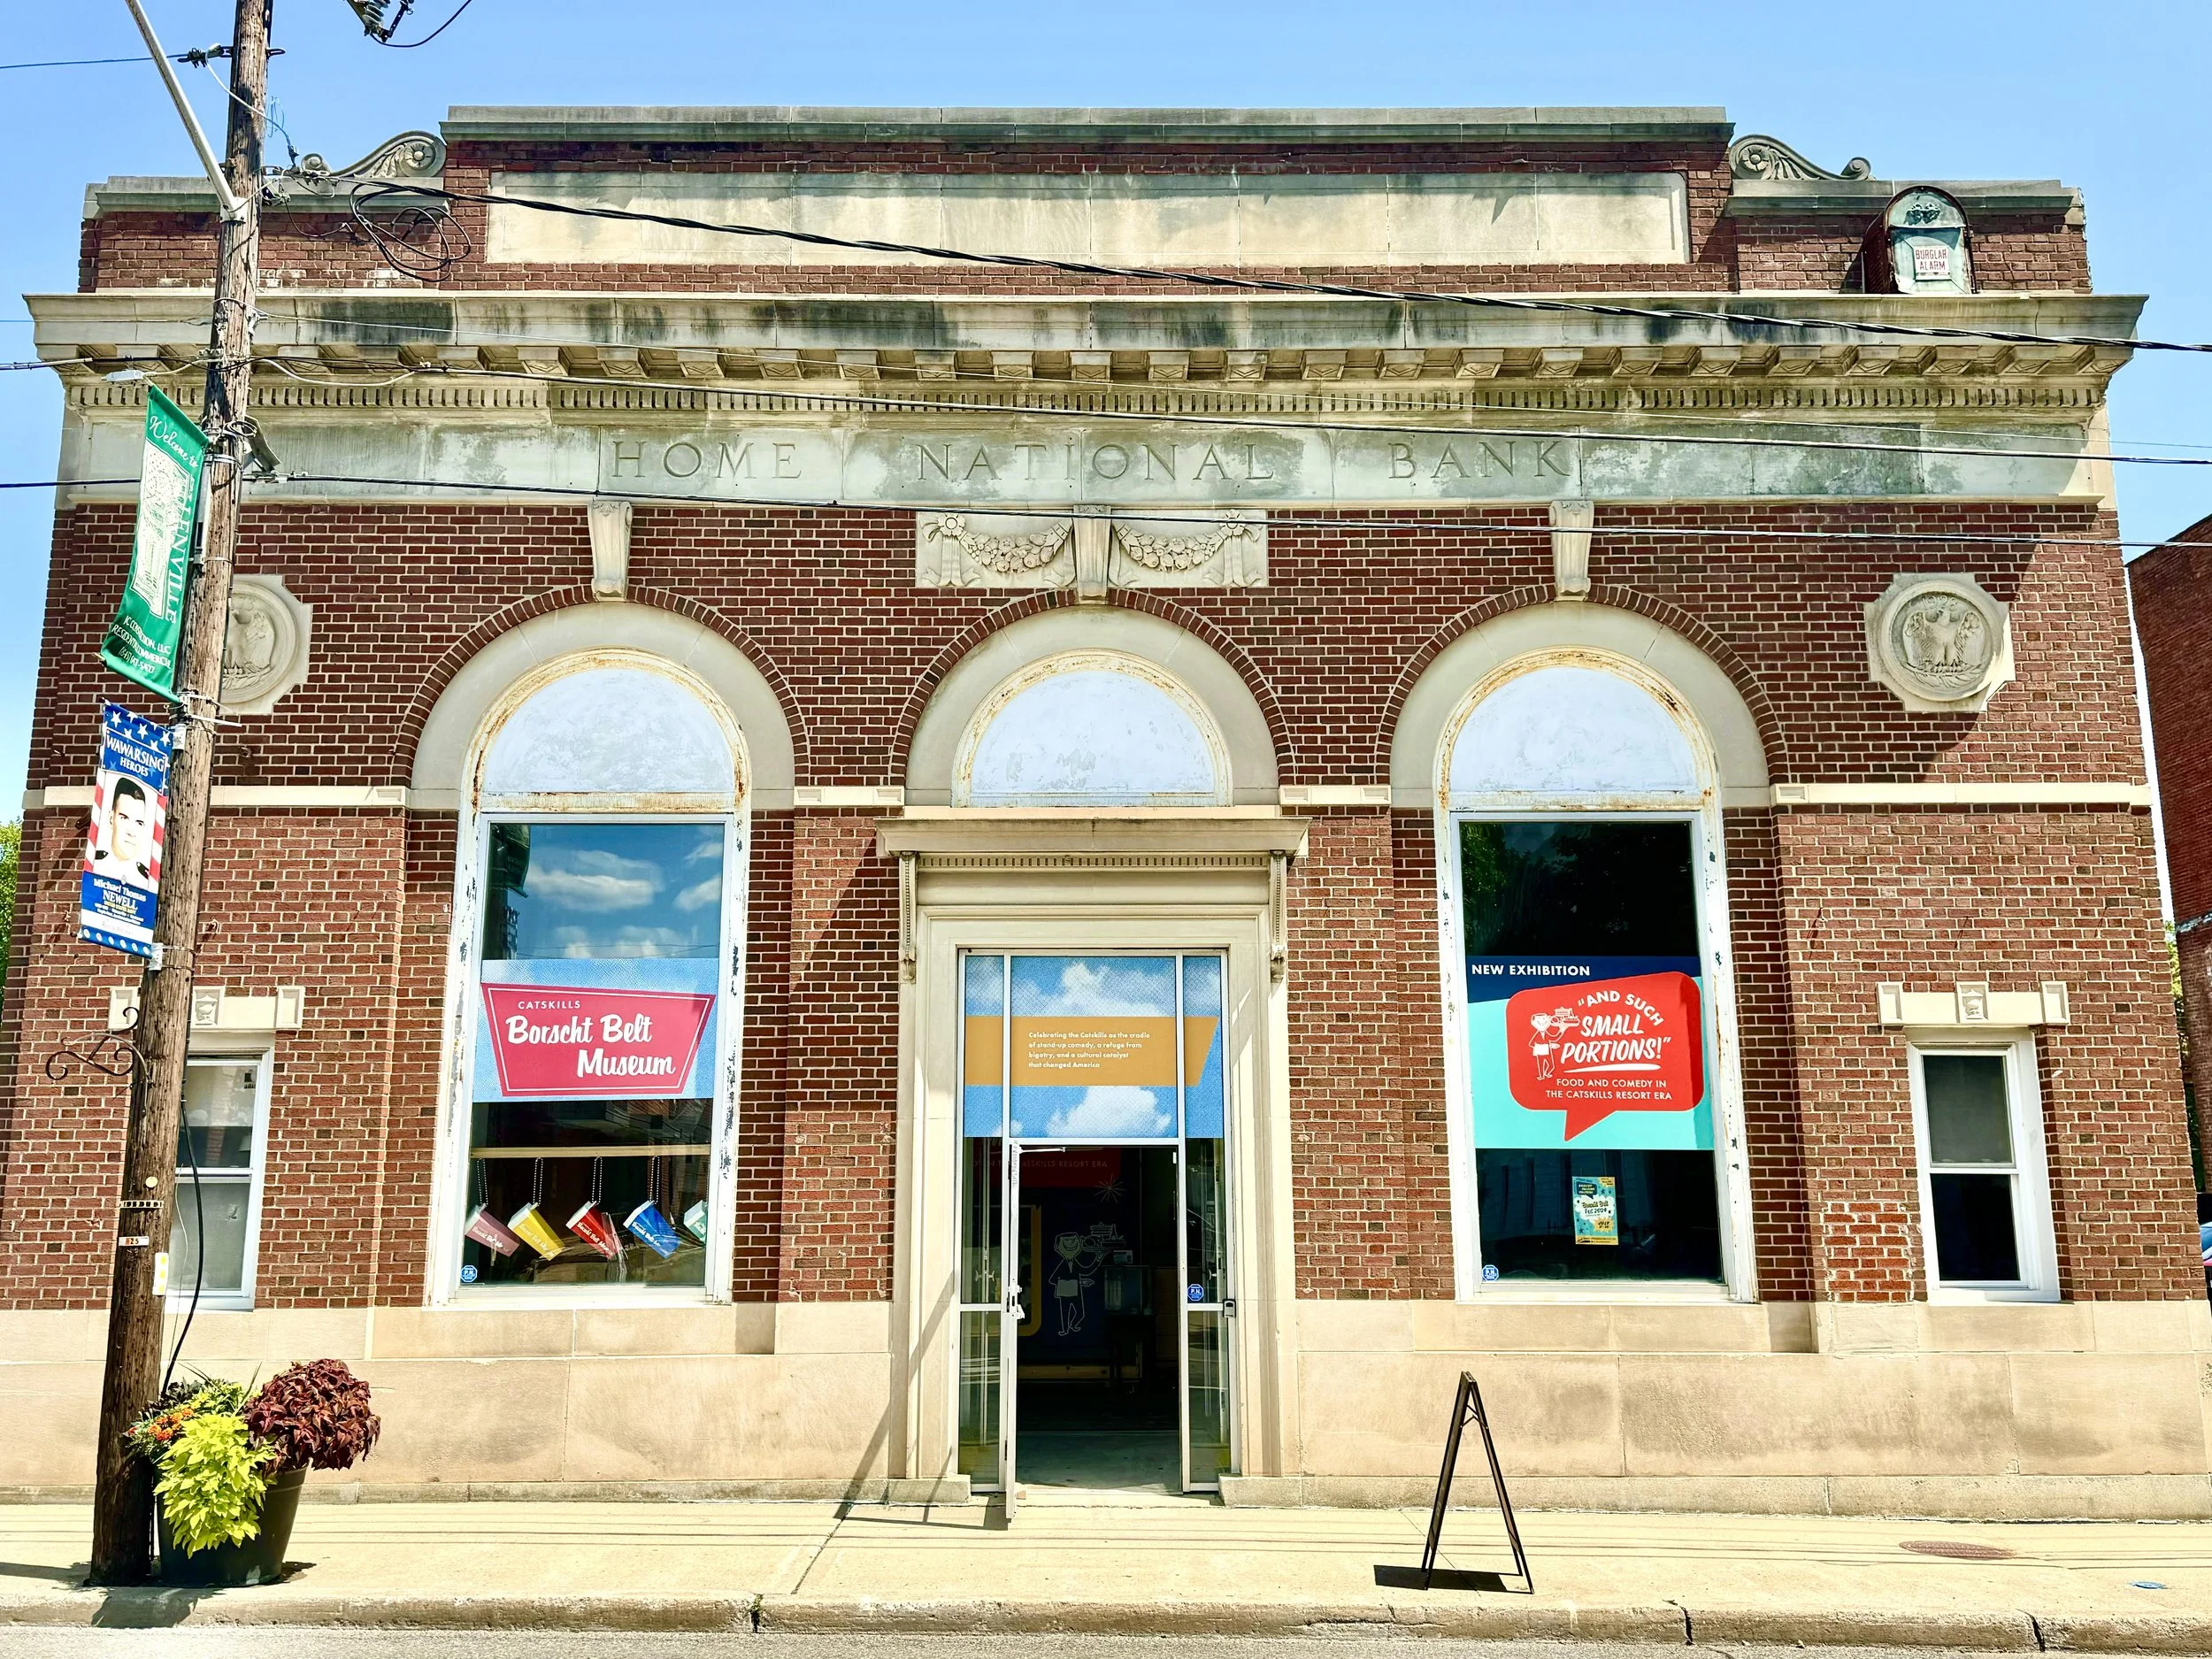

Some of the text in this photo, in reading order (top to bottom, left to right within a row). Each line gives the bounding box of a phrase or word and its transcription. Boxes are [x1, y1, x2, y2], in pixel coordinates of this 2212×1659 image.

[1915, 250, 1947, 259] BURGLAR
[1919, 261, 1947, 271] ALARM
[150, 416, 199, 468] Welcome to
[611, 440, 1571, 481] HOME NATIONAL BANK
[165, 474, 196, 625] LENVILLE
[1922, 595, 1958, 611] 1928
[106, 734, 165, 772] WAWARSING
[120, 757, 149, 777] HEROES
[103, 890, 138, 910] NEWELL
[122, 887, 147, 902] Thomas
[1471, 964, 1590, 976] NEW EXHIBITION
[518, 1000, 580, 1010] CATSKILLS
[1624, 993, 1664, 1027] SUCH
[505, 1012, 653, 1045] Borscht Belt
[1579, 1013, 1644, 1038] SMALL
[577, 1048, 676, 1078] Museum
[1556, 1079, 1667, 1088] FOOD AND COMEDY IN
[1546, 1090, 1672, 1100] THE CATSKILLS RESORT ERA
